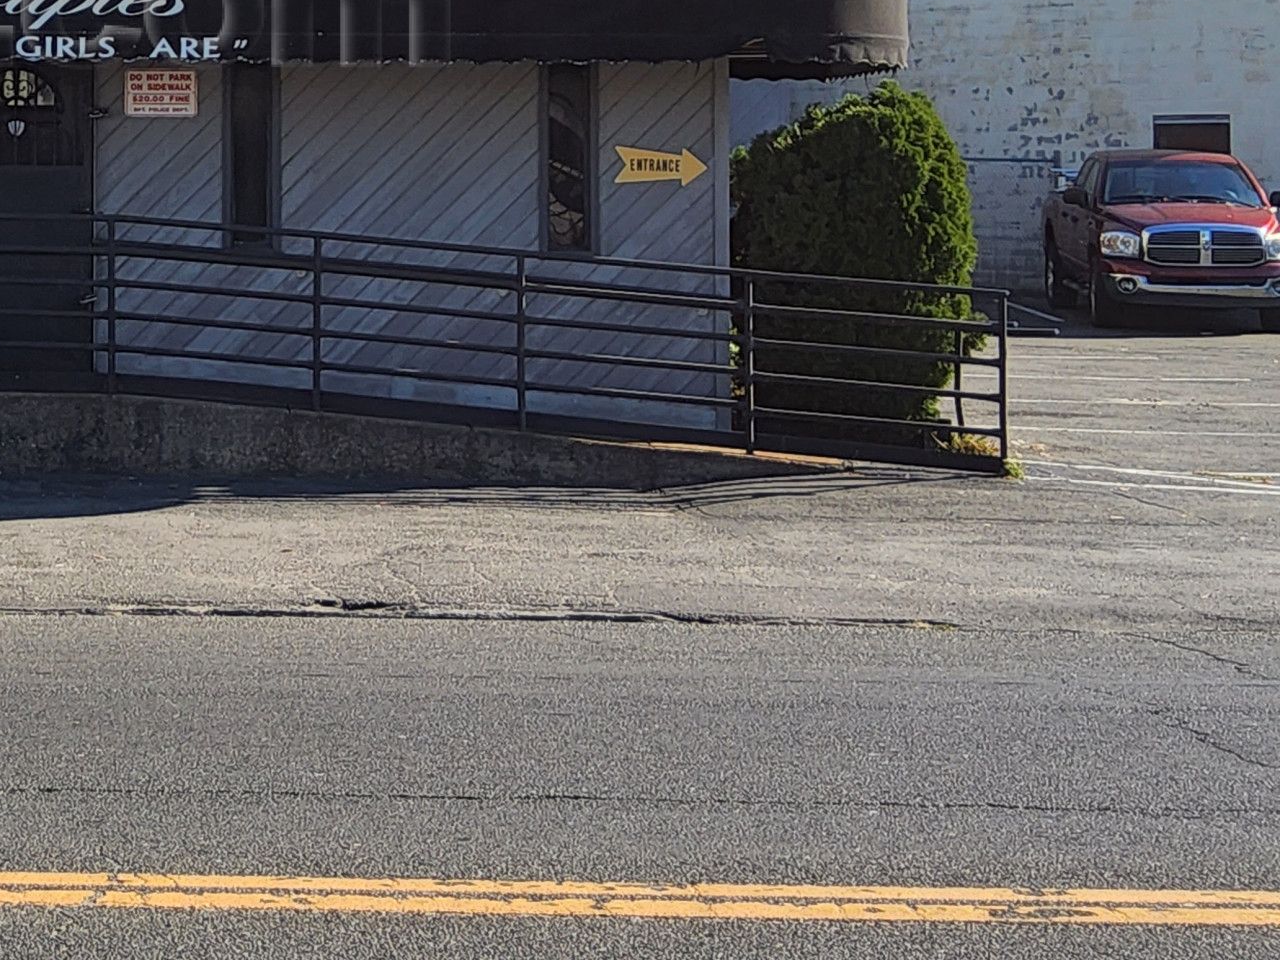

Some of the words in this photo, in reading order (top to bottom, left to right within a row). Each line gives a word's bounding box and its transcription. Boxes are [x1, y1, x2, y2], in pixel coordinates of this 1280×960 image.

[16, 35, 116, 59] GIRLS
[129, 73, 143, 81] DO
[146, 73, 165, 81] NOT
[168, 73, 192, 81] PARK
[130, 83, 143, 91] ON
[147, 83, 192, 91] SIDEWALK
[629, 158, 680, 173] ENTRANCE
